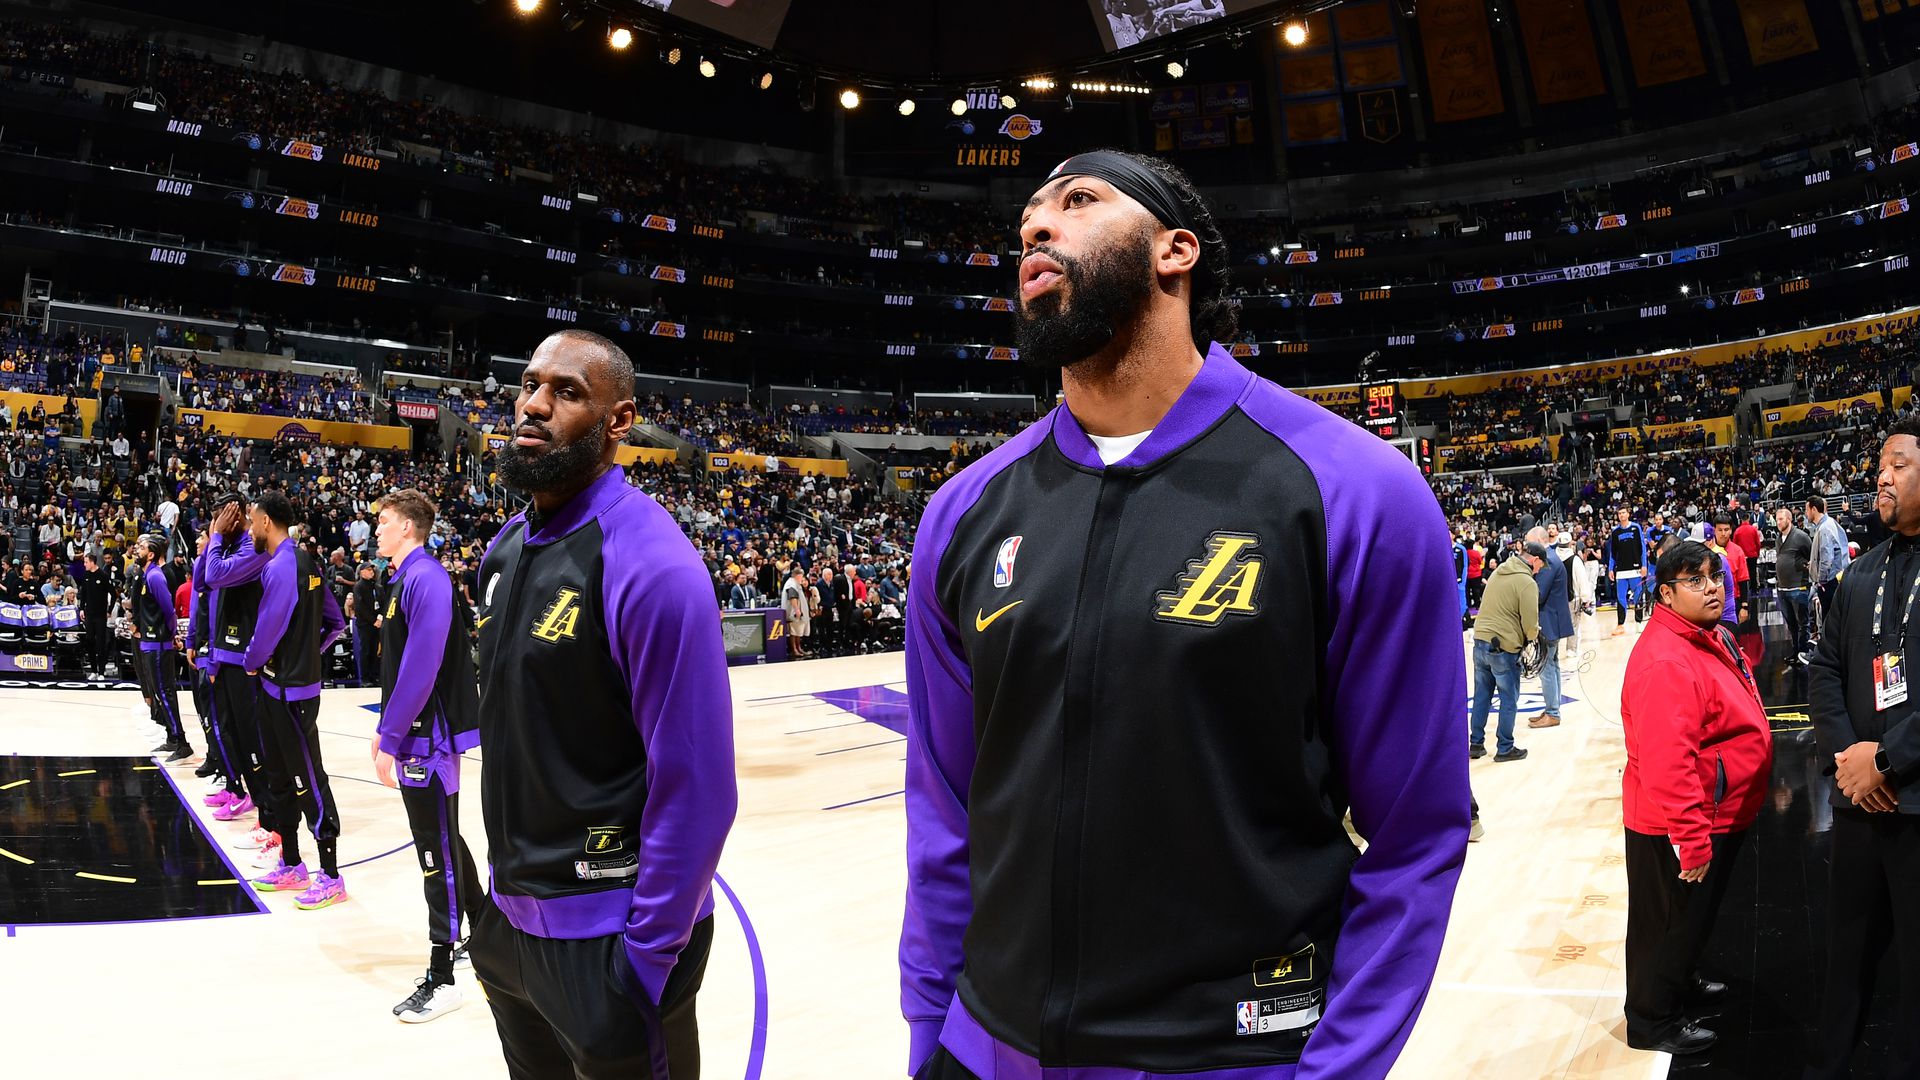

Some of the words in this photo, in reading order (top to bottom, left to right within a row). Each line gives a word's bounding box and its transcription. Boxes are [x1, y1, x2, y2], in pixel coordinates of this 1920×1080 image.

[167, 120, 202, 136] MAGIC
[999, 118, 1043, 136] LAKERS
[343, 153, 381, 170] LAKERS
[958, 149, 1020, 165] LAKERS
[1805, 171, 1830, 185] MAGIC
[156, 179, 192, 196] MAGIC
[542, 195, 571, 210] MAGIC
[340, 210, 378, 227] LAKERS
[1643, 207, 1671, 220] LAKERS
[693, 225, 723, 239] LAKERS
[1505, 230, 1531, 241] MAGIC
[1791, 224, 1816, 238] MAGIC
[150, 247, 186, 264] MAGIC
[546, 248, 576, 263] MAGIC
[870, 248, 897, 259] MAGIC
[1335, 248, 1364, 258] LAKERS
[1657, 254, 1664, 265] 0
[1619, 261, 1639, 270] Magic
[1884, 256, 1908, 272] MAGIC
[1535, 273, 1558, 282] Lakers
[1567, 264, 1599, 279] 12:00
[337, 276, 375, 291] LAKERS
[703, 275, 734, 288] LAKERS
[1511, 275, 1518, 286] 0
[1780, 279, 1809, 294] LAKERS
[885, 295, 913, 305] MAGIC
[1360, 289, 1391, 300] LAKERS
[547, 307, 577, 322] MAGIC
[1641, 305, 1666, 317] MAGIC
[1533, 320, 1562, 331] LAKERS
[1826, 327, 1858, 342] LOS
[1862, 313, 1920, 336] ANGEL
[703, 330, 734, 342] LAKERS
[1388, 335, 1415, 345] MAGIC
[887, 345, 915, 355] MAGIC
[1276, 342, 1308, 353] LAKERS
[1621, 354, 1692, 374] LAKERS
[1369, 385, 1393, 398] 12:00
[398, 404, 436, 418] SHIBA
[1369, 397, 1393, 417] 24
[1374, 416, 1397, 425] TISSOT
[1767, 414, 1780, 422] 107
[714, 457, 728, 466] 103
[1158, 537, 1260, 622] LA
[6, 609, 20, 617] PRIME
[532, 589, 580, 641] LA
[22, 656, 44, 667] PRIME
[0, 680, 141, 689] OYOTA
[1262, 1004, 1273, 1013] XL
[1261, 1018, 1269, 1030] 3
